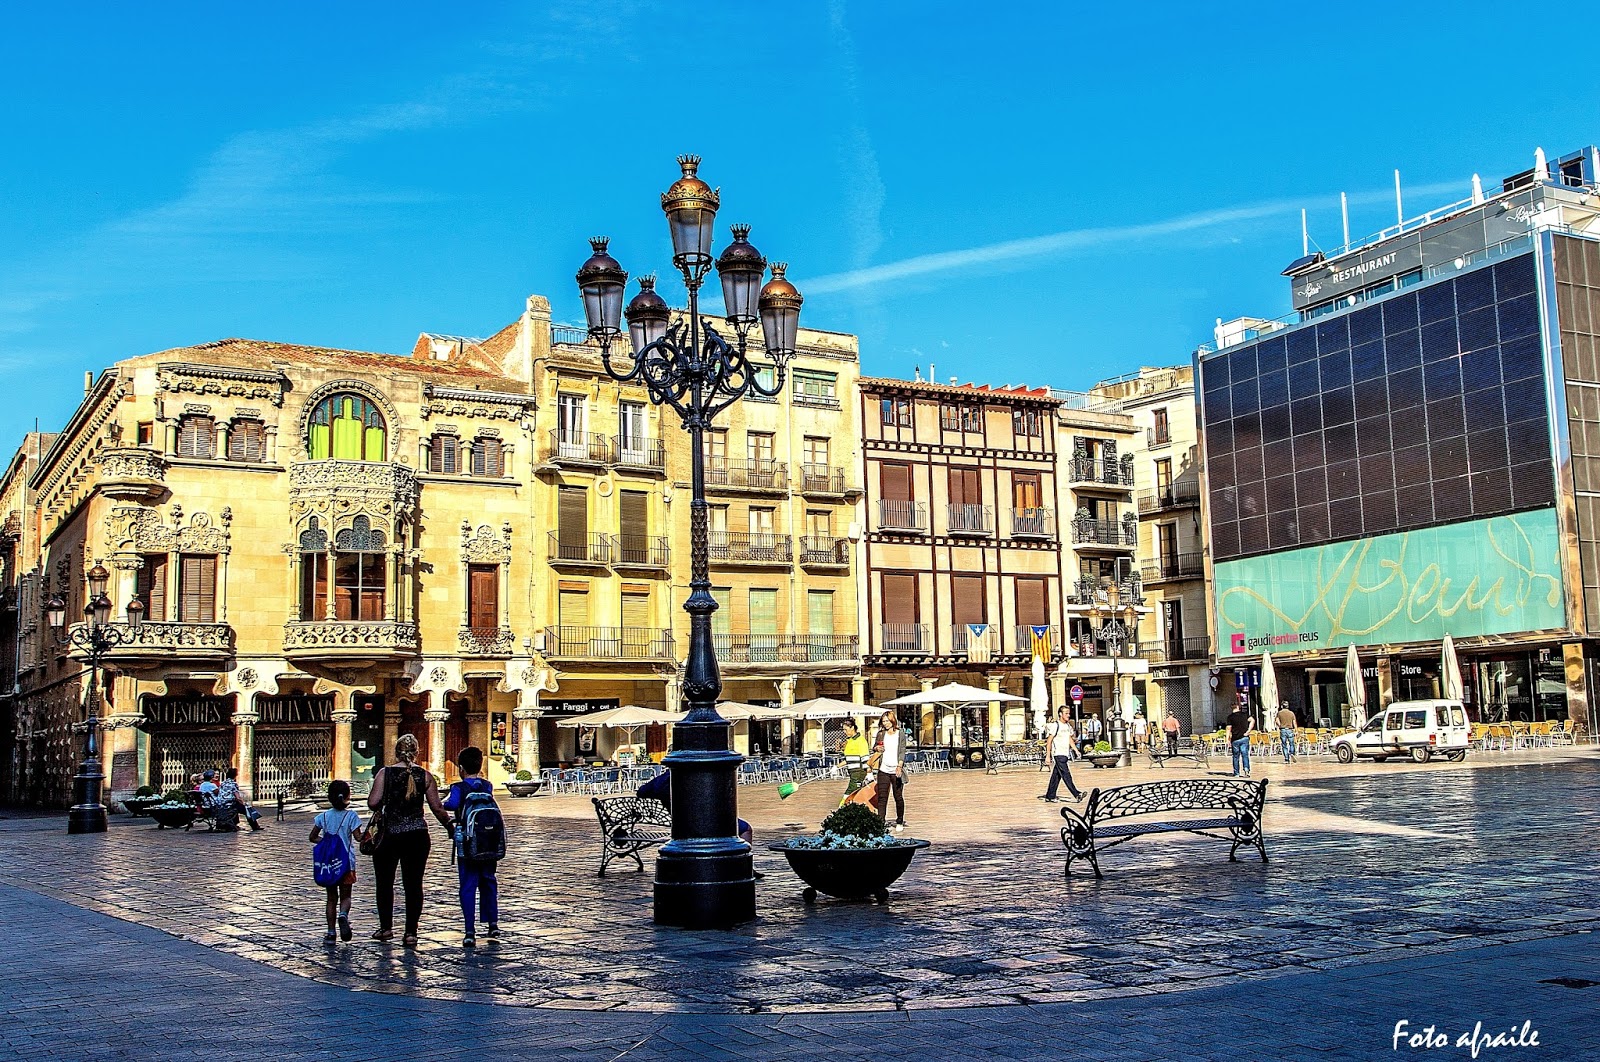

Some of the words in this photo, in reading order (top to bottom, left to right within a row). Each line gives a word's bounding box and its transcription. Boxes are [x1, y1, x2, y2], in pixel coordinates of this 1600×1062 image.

[1332, 252, 1398, 283] RESTAURANT
[1165, 603, 1173, 631] OUTLET
[1401, 664, 1422, 676] Store
[562, 702, 589, 712] Farggi
